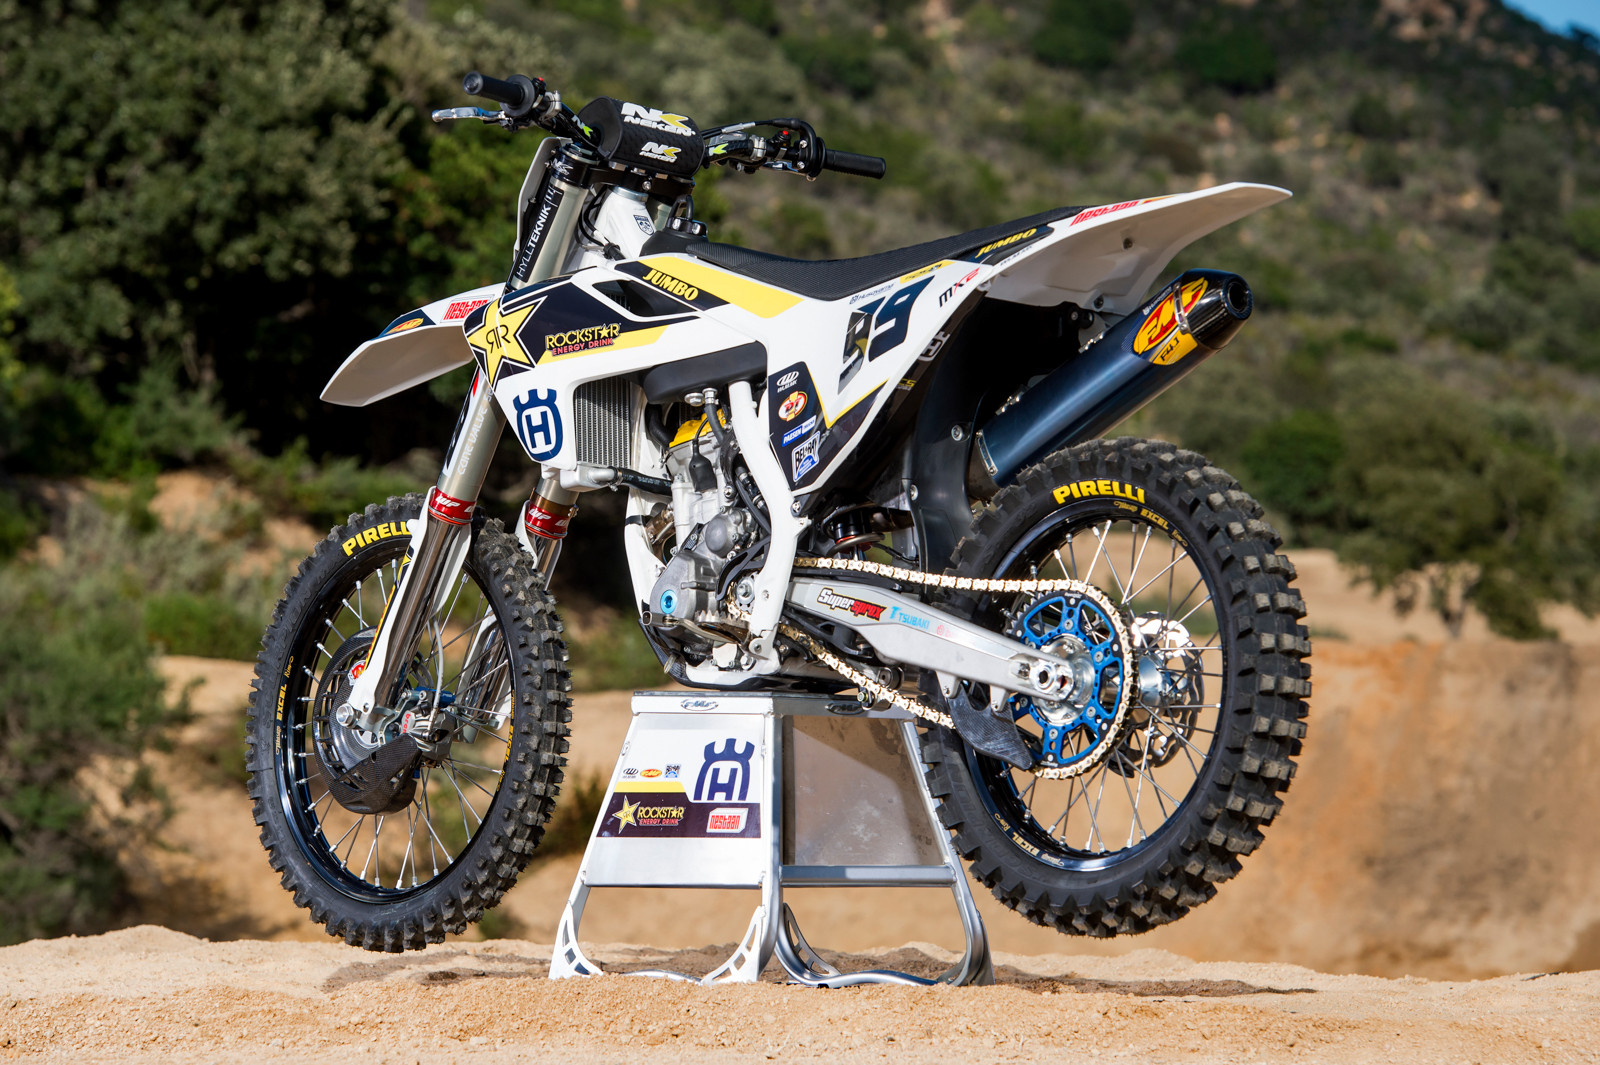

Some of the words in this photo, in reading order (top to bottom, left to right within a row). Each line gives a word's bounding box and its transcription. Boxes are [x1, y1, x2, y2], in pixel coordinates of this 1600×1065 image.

[515, 204, 552, 278] HYLLTEKNIK
[975, 228, 1038, 259] JUMBO
[642, 268, 699, 301] JUMBO
[552, 343, 585, 356] ENERGY
[588, 337, 613, 349] DRINK
[1052, 480, 1146, 504] PIRELLI
[1140, 508, 1169, 530] EXCEL
[342, 521, 412, 557] PIRELL
[898, 613, 930, 630] TSUBAKI
[276, 683, 287, 721] EXCEL
